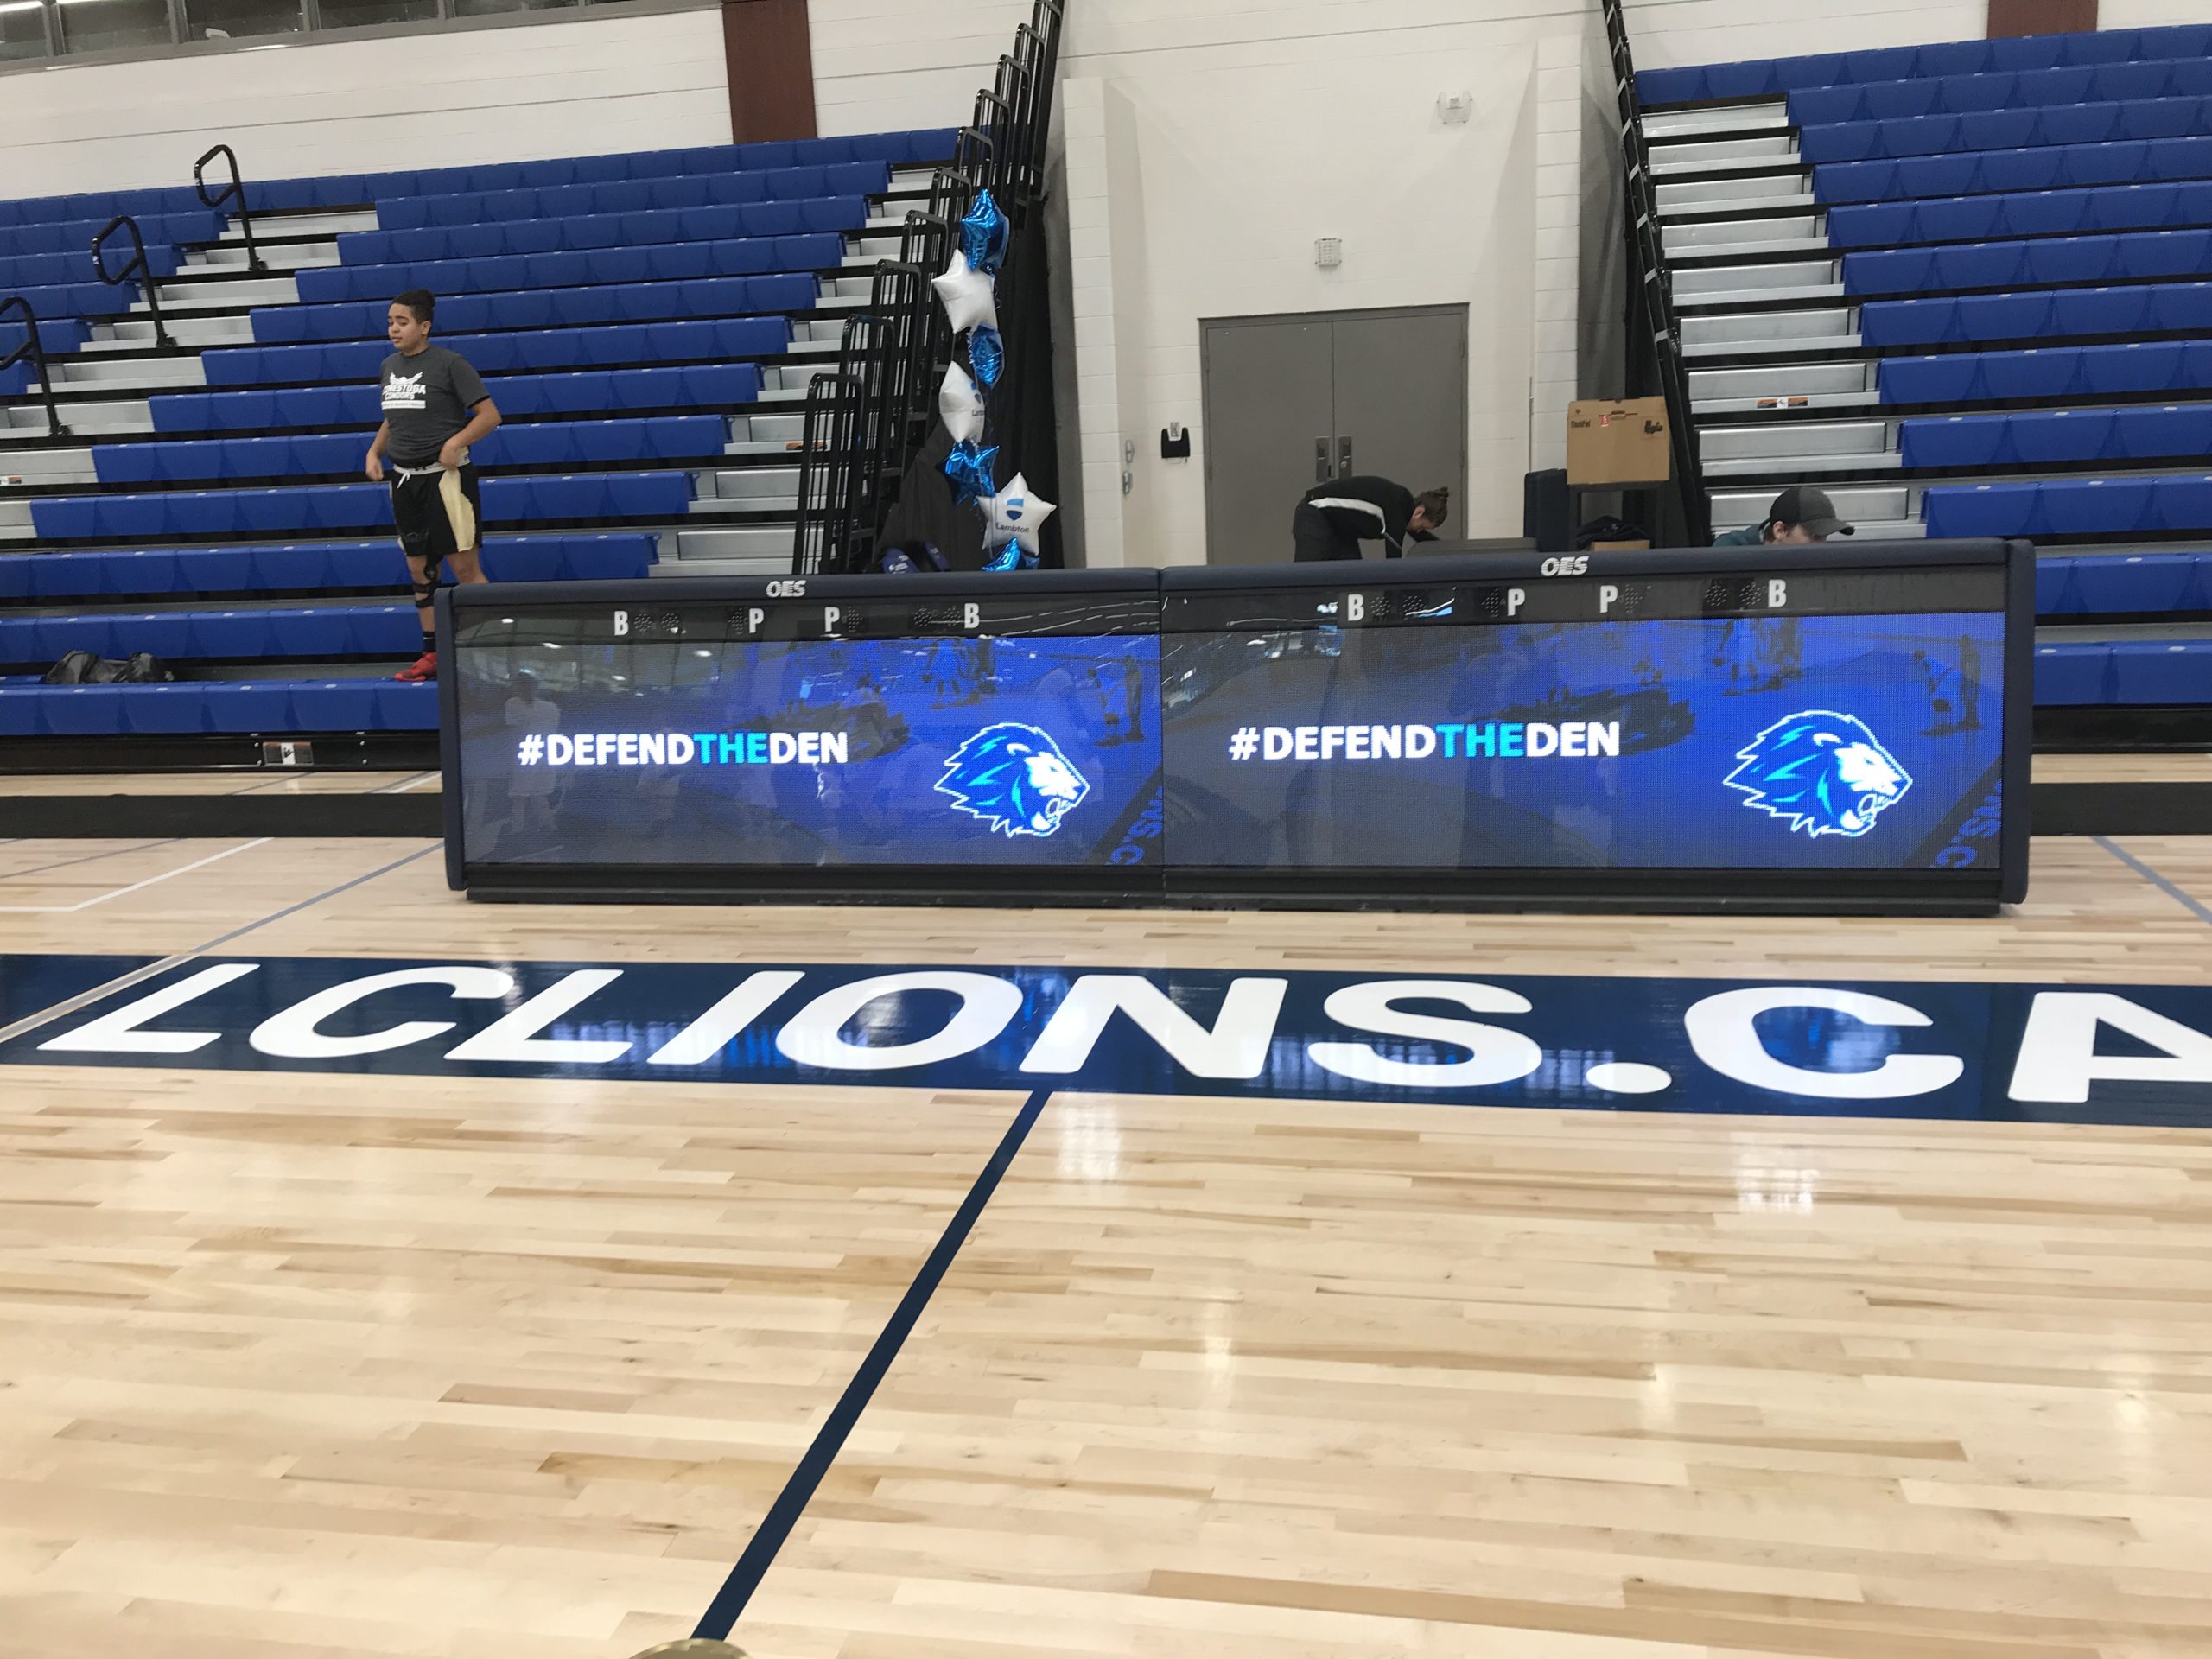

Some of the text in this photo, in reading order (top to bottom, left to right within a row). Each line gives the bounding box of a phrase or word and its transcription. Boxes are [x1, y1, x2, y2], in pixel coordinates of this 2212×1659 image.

[996, 523, 1030, 533] Lambton
[1541, 556, 1590, 577] OES
[766, 580, 807, 598] OES
[1348, 579, 1786, 621] B P P B
[614, 603, 980, 636] B P P B
[518, 732, 849, 766] #DEFENDTHEDEN
[1229, 721, 1620, 760] #DEFENDTHEDEN
